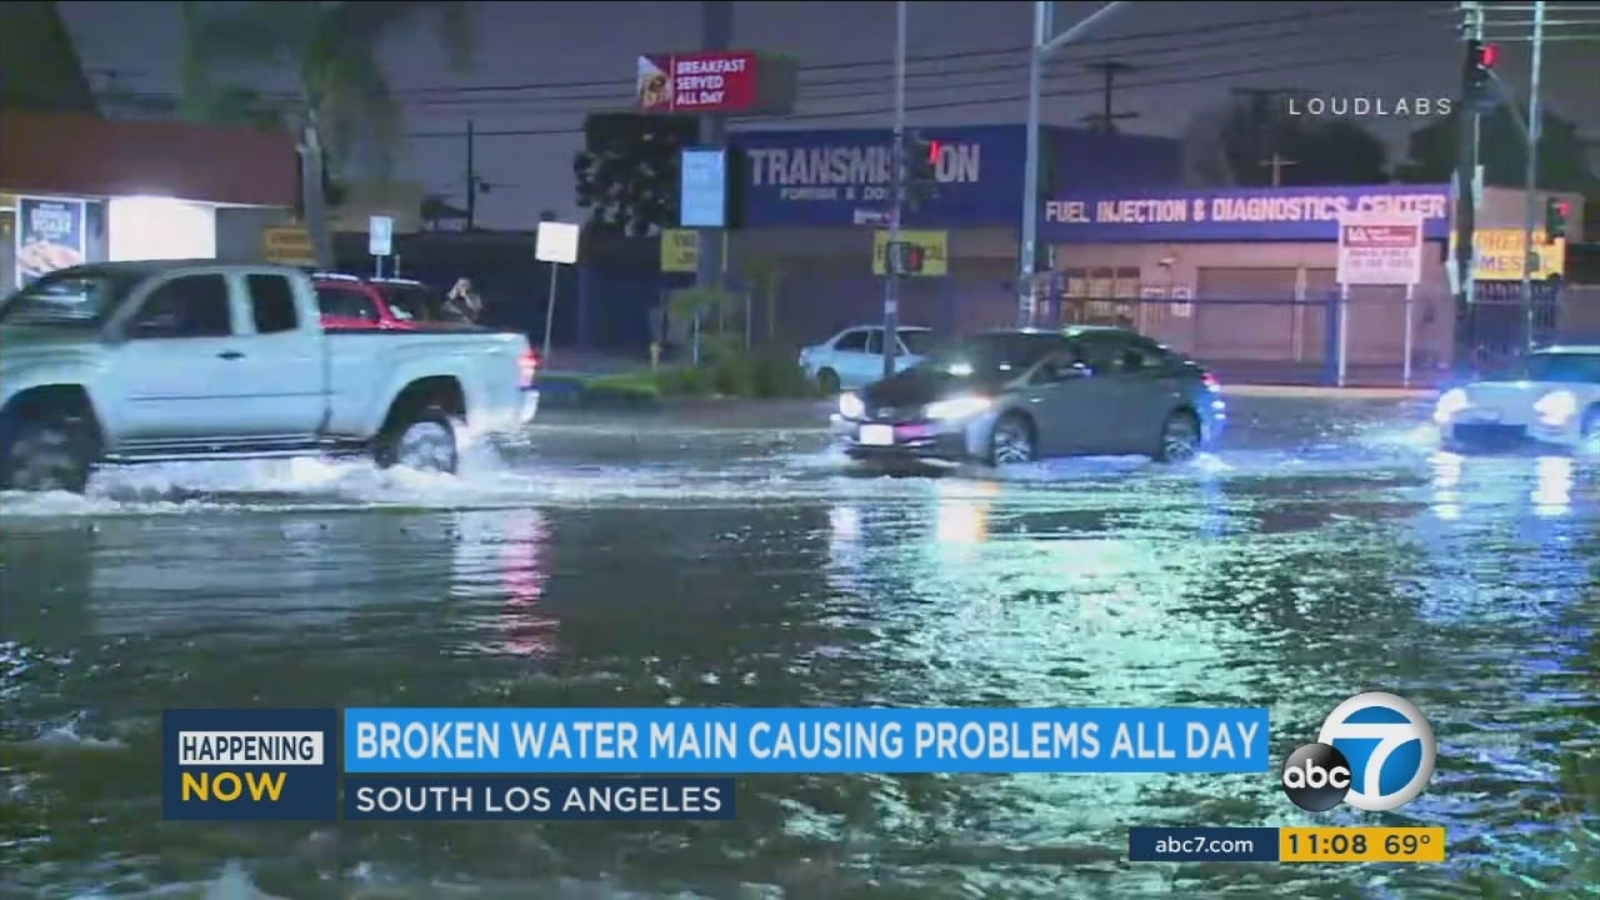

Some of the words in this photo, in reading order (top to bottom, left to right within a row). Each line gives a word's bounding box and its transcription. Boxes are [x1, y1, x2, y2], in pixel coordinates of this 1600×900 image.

[677, 59, 746, 74] BREAKFAST
[677, 76, 724, 90] SERVED
[677, 92, 698, 105] ALL
[700, 91, 725, 104] DAY
[748, 144, 980, 185] TRANSMION
[1046, 201, 1090, 222] FUEL
[1097, 199, 1186, 222] INJECTION
[1193, 199, 1204, 221] &
[1212, 196, 1344, 220] DIAGNOSTICS
[1356, 194, 1446, 218] CENTER
